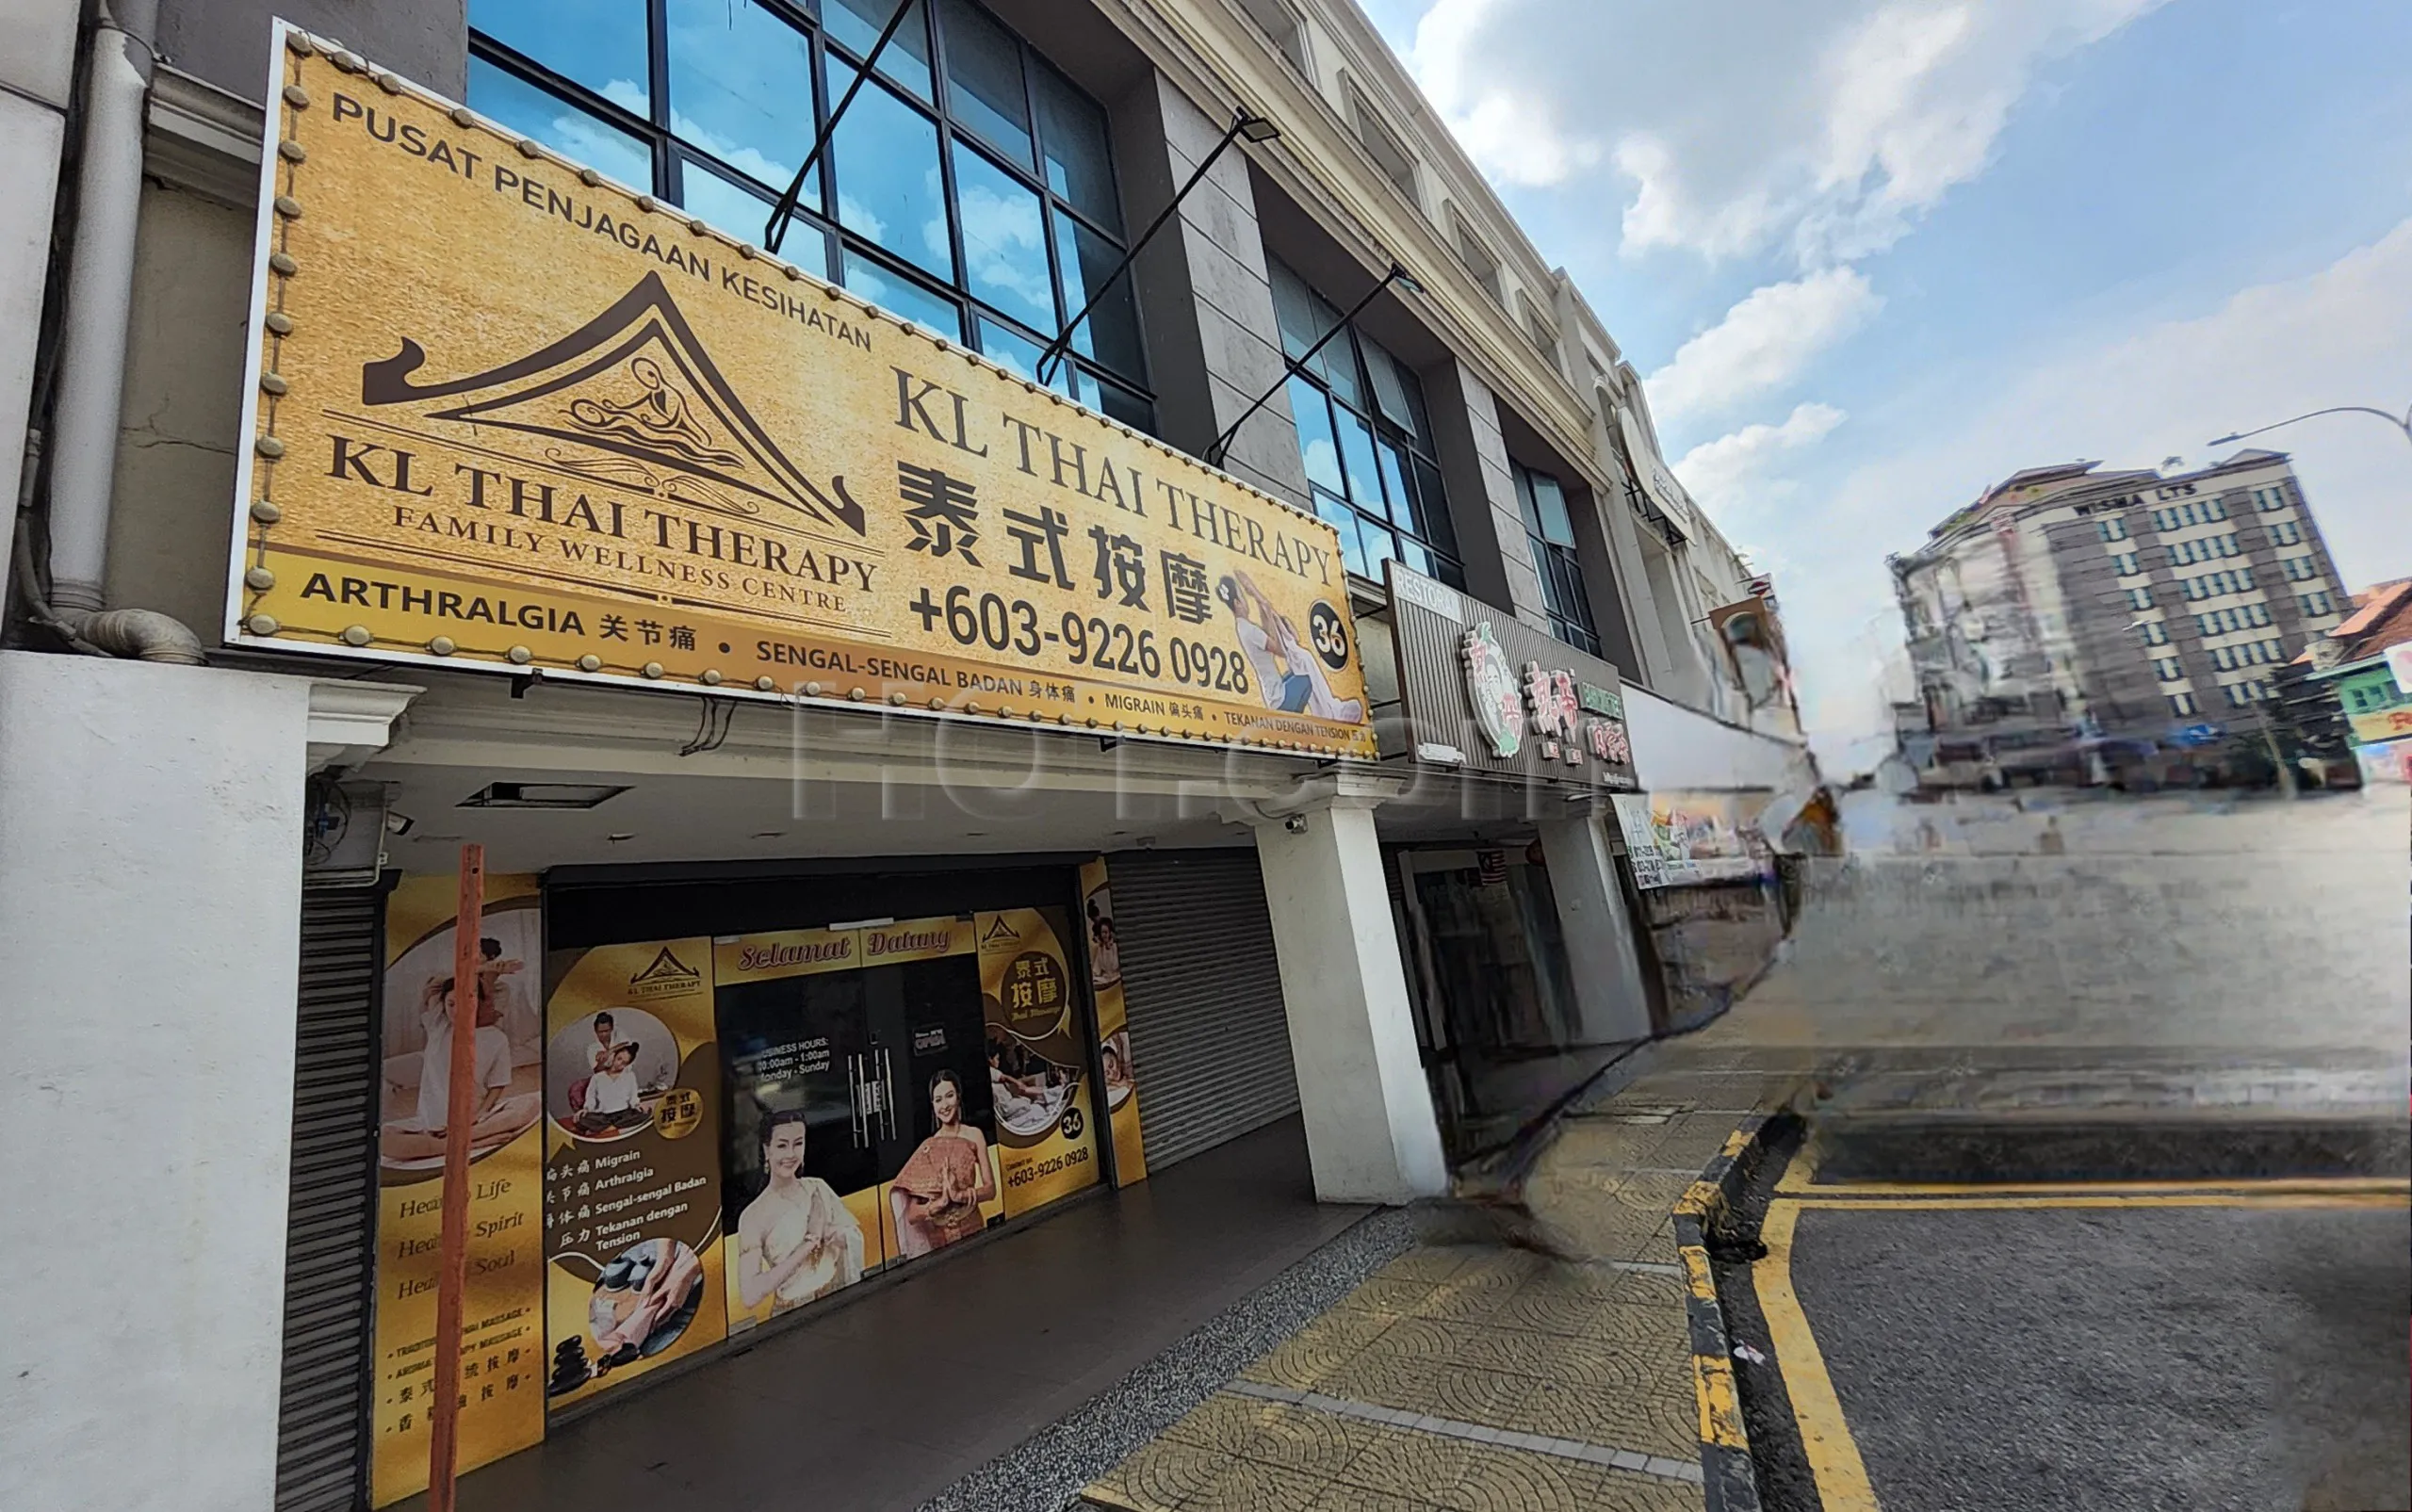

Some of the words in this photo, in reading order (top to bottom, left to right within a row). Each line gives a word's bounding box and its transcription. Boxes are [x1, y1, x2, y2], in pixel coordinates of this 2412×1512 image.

[333, 91, 482, 181] PUSAT
[495, 165, 710, 281] PENJAGAAN
[722, 266, 872, 352] KESIHATAN
[888, 366, 988, 458] KL
[1002, 412, 1149, 518] THAI
[1156, 477, 1331, 588] THERAPY
[2155, 483, 2198, 501] LTS
[324, 434, 433, 497] KL
[456, 467, 627, 541] THAI
[644, 509, 878, 594] THERAPY
[896, 460, 1214, 626] 泰式按摩
[394, 506, 544, 554] FAMILY
[560, 539, 731, 591] WELLNESS
[742, 577, 847, 613] CENTRE
[300, 572, 586, 637] ARTHRALGIA
[599, 613, 697, 653] 关节痛
[909, 584, 1162, 679] +603-9226
[1173, 635, 1249, 695] 0928
[1312, 613, 1347, 657] 36
[757, 640, 952, 687] SENGAL-SENGAL
[956, 671, 1024, 697] BADAN
[1028, 679, 1077, 704] 身体痛
[1104, 692, 1166, 717] MIGRAIN
[1169, 701, 1204, 722] 偏头痛
[1224, 710, 1274, 731] TEKANAN
[1275, 719, 1314, 737] DENGAN
[1314, 724, 1351, 742] TENSION
[737, 936, 853, 971] Selamat
[867, 930, 952, 956] Datang
[1015, 956, 1051, 979] 泰式
[1010, 977, 1059, 1009] 按摩
[760, 1042, 798, 1059] USINESS
[798, 1036, 830, 1051] HOURS:
[800, 1049, 831, 1063] 1:00am
[799, 1060, 831, 1075] Sunday
[1062, 1112, 1082, 1135] 36
[595, 1149, 641, 1169] Migrain
[1007, 1155, 1064, 1188] +603-9226
[1064, 1146, 1089, 1167] 0928
[475, 1179, 513, 1201] Life
[595, 1167, 654, 1192] Arthralgia
[595, 1183, 673, 1215] Sengal-sengal
[674, 1176, 707, 1193] Badan
[475, 1211, 525, 1239] Spirit
[595, 1213, 645, 1237] Tekanan
[646, 1201, 689, 1224] dengan
[560, 1227, 591, 1250] 压力
[595, 1230, 641, 1252] Tension
[475, 1249, 516, 1275] Soul
